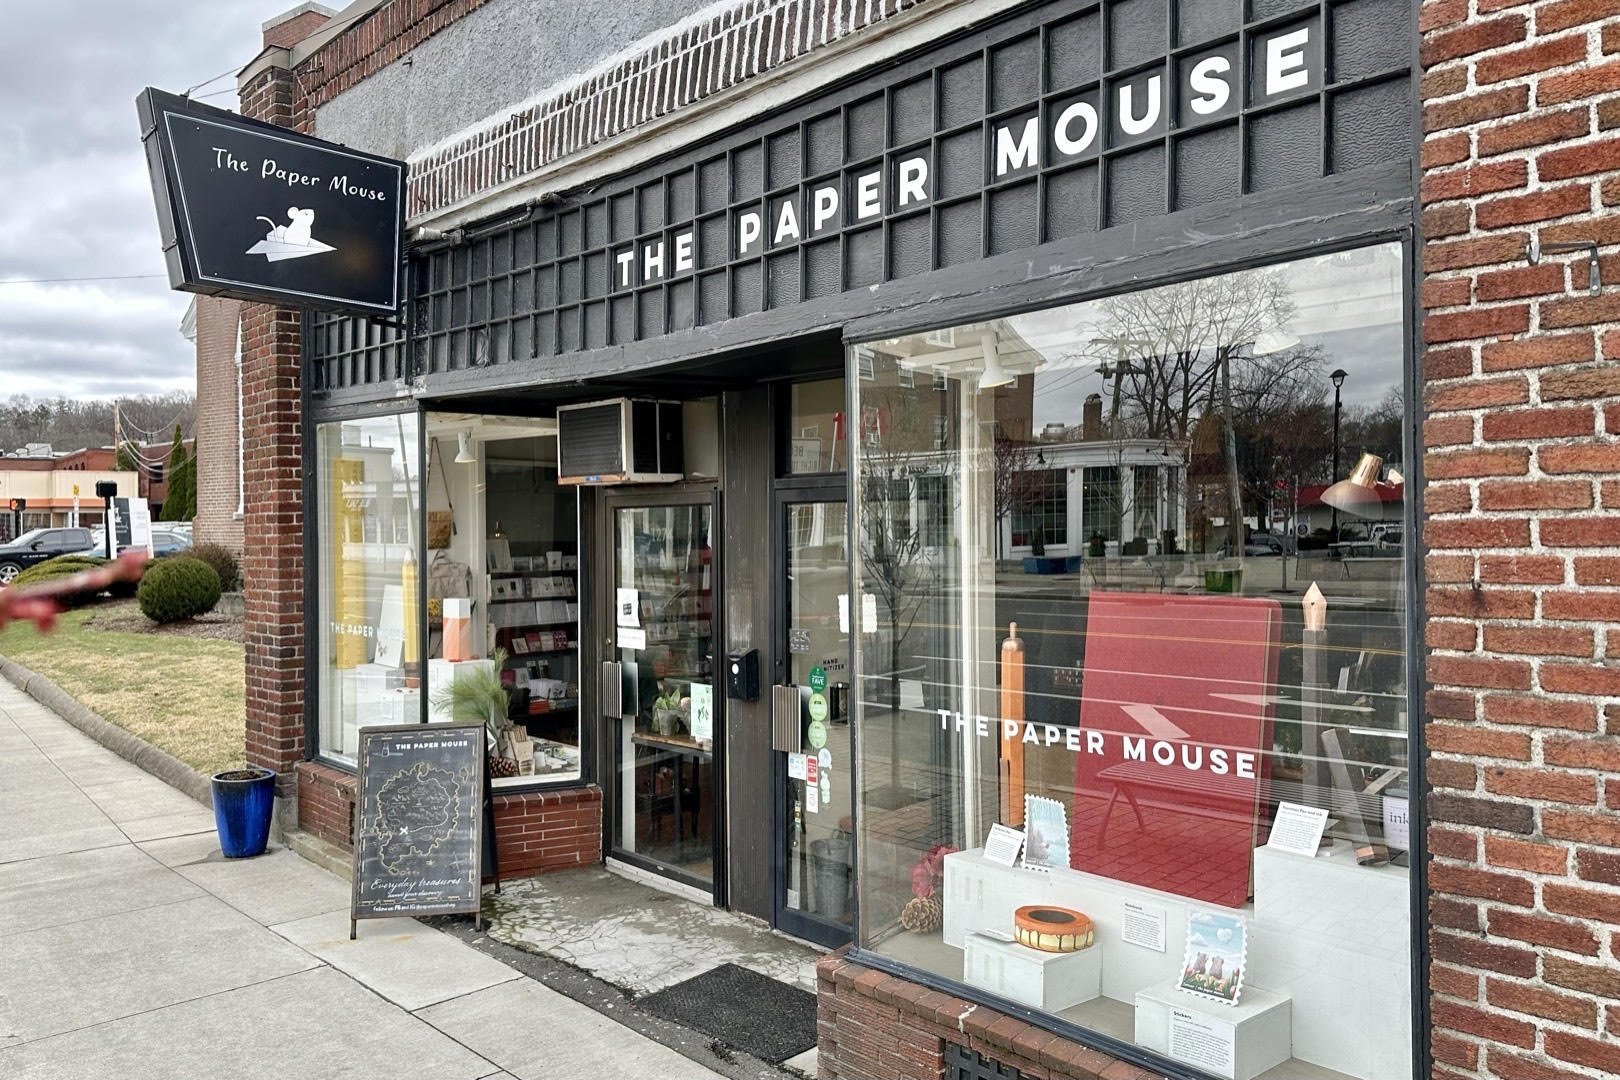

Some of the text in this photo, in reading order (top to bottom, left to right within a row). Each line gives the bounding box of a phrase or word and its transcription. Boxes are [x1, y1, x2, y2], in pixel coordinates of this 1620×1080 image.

[616, 27, 1309, 286] THE PAPER MOUSE
[211, 147, 386, 201] The Paper Mouse
[331, 622, 345, 634] THE
[347, 624, 373, 637] PAPER
[441, 740, 468, 748] MOUSE
[937, 709, 1256, 779] THE PAPER MOUSE
[370, 877, 461, 895] Everyday treasures
[1173, 1011, 1192, 1020] Stickers
